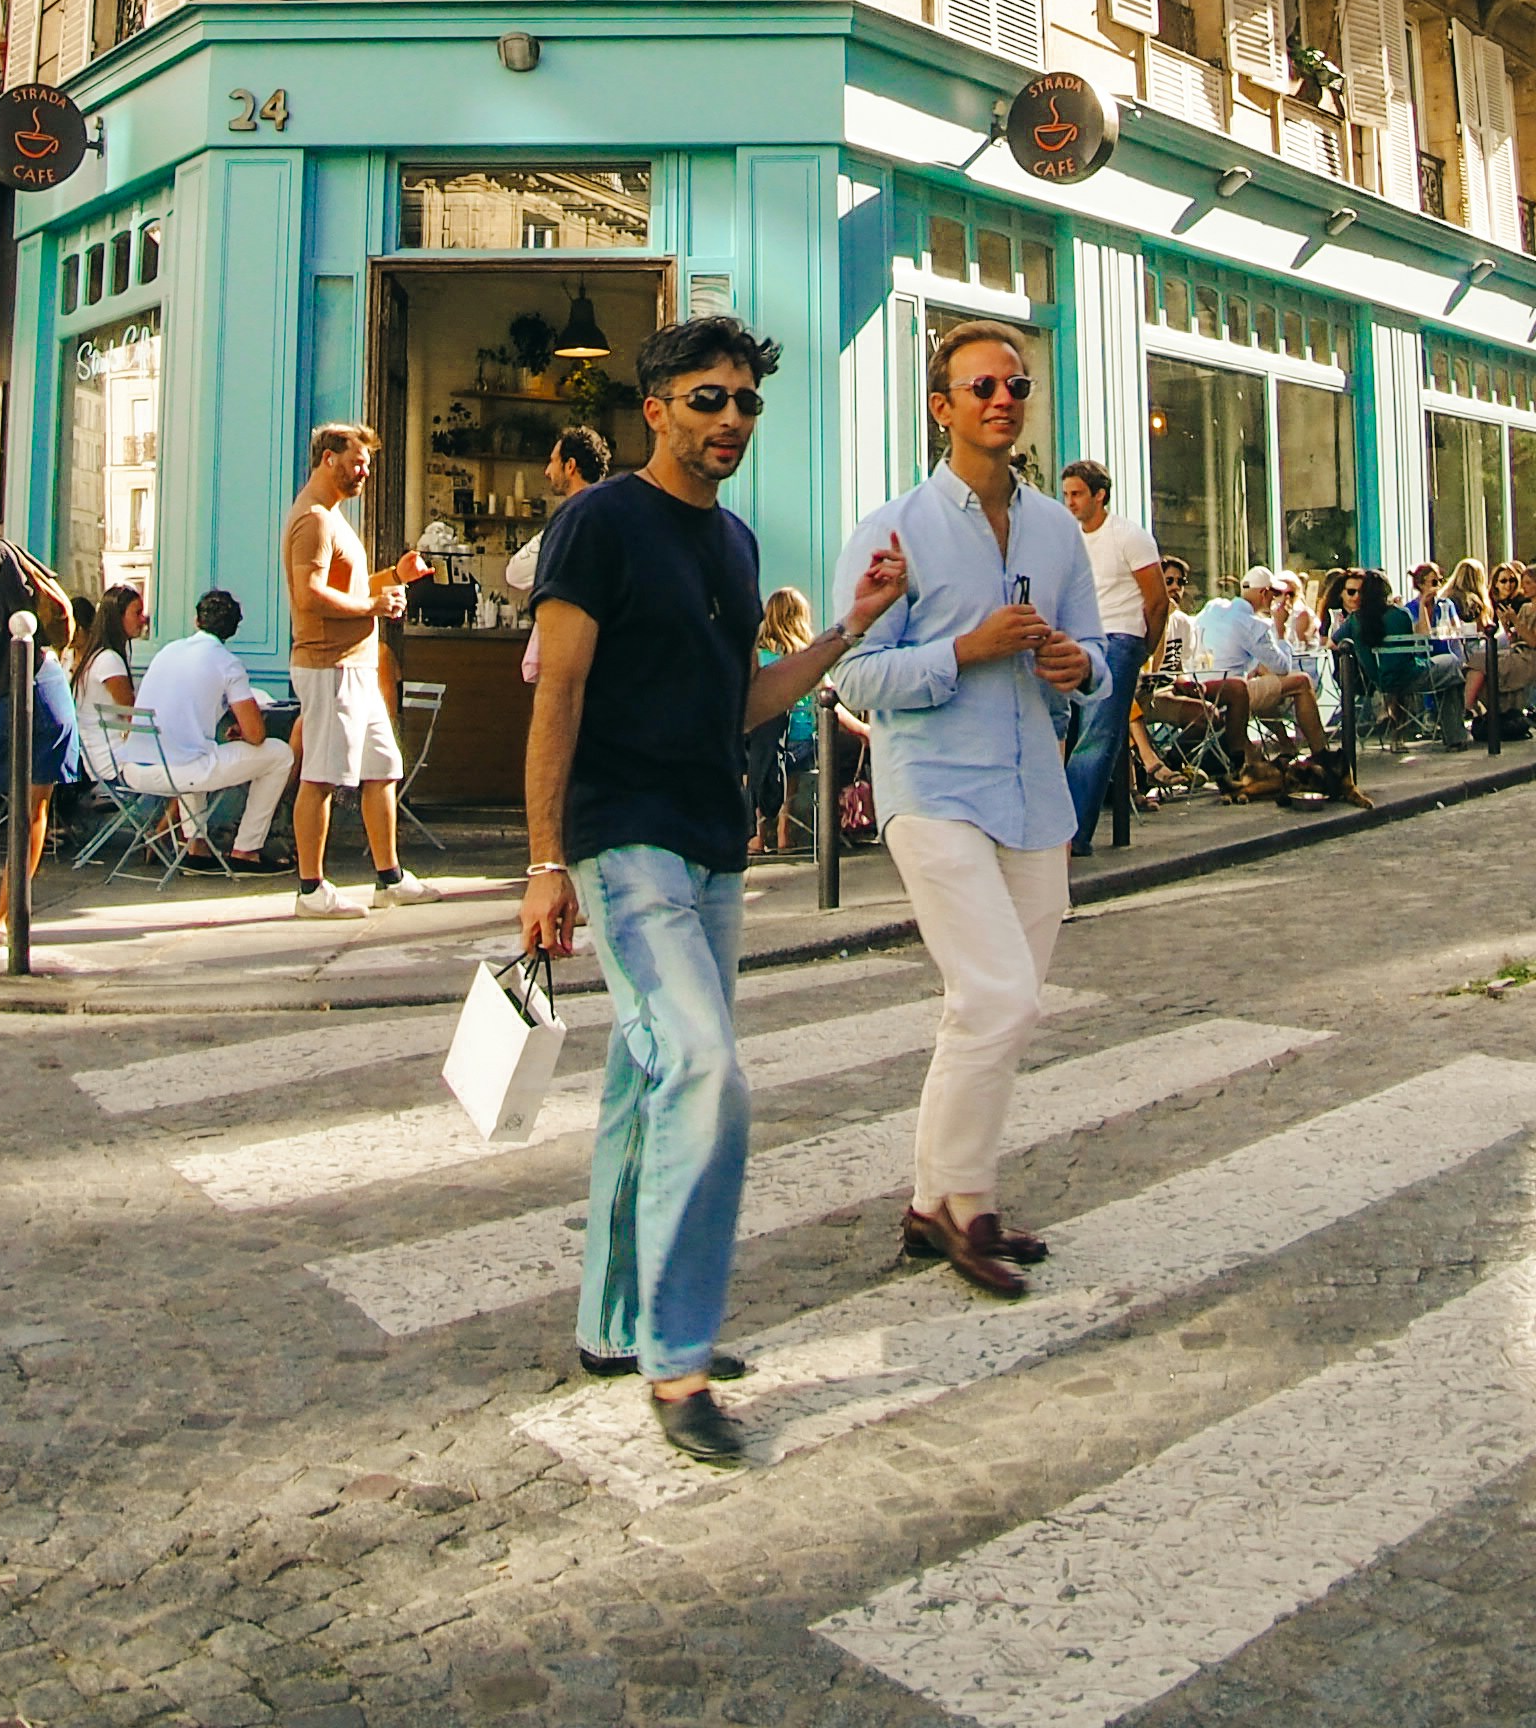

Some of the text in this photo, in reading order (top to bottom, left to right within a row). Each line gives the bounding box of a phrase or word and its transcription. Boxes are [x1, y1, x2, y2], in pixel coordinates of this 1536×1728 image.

[1029, 76, 1082, 98] STRADA
[12, 88, 67, 109] STRADA
[228, 88, 289, 132] 24
[13, 165, 55, 184] CAFE
[1033, 157, 1075, 177] CAFE
